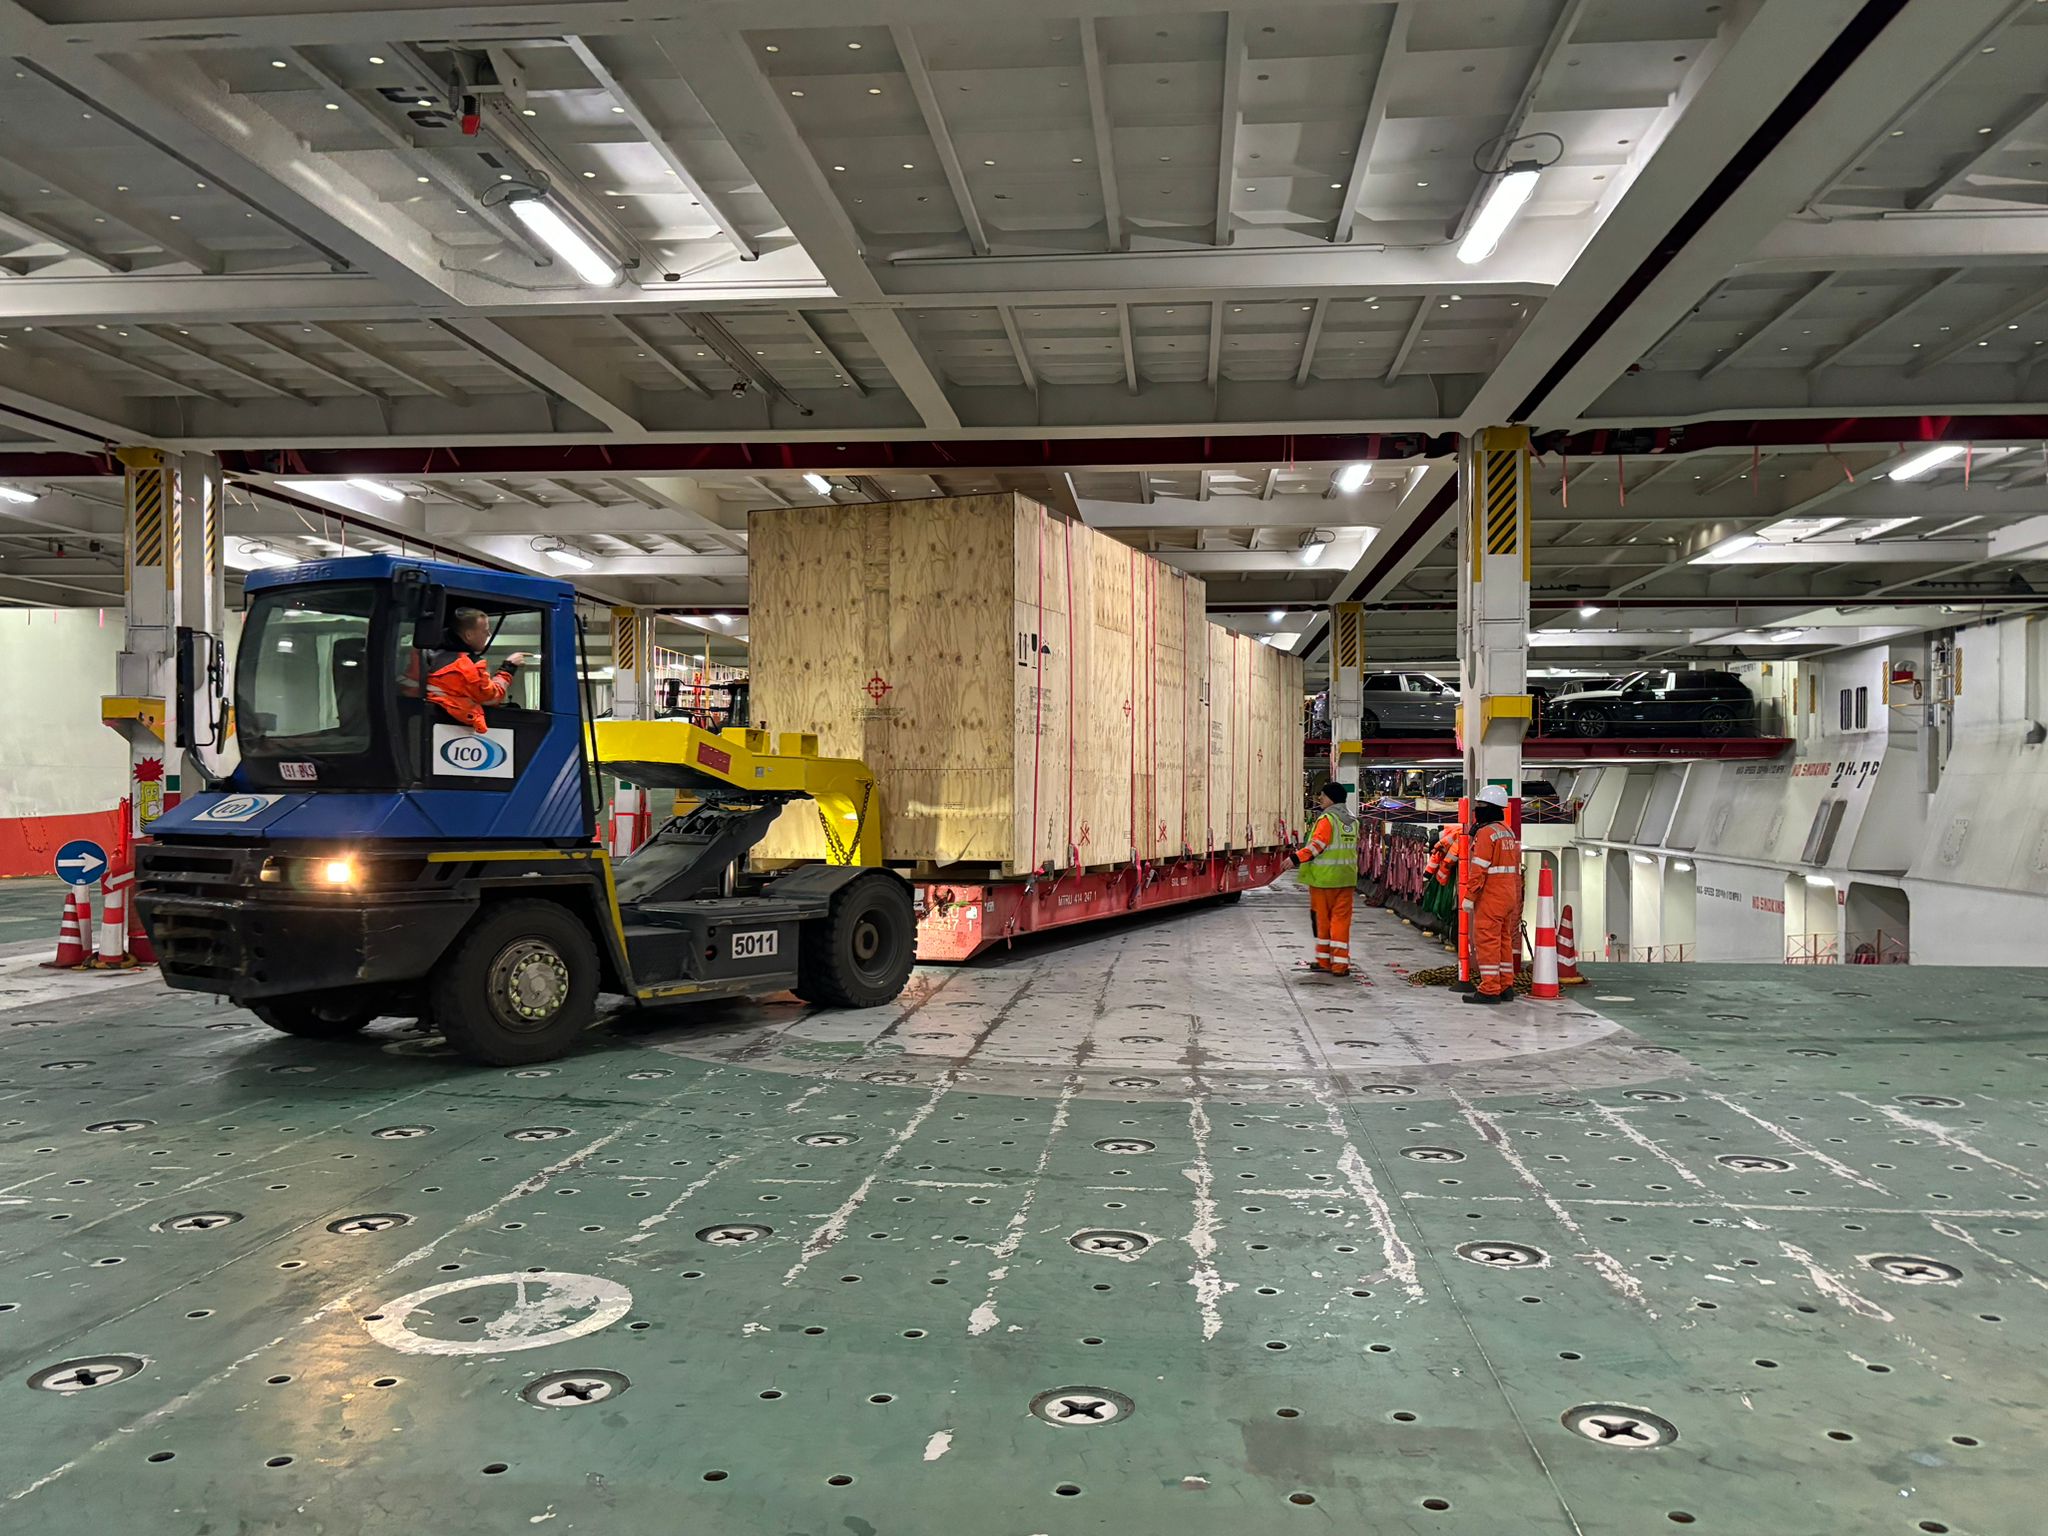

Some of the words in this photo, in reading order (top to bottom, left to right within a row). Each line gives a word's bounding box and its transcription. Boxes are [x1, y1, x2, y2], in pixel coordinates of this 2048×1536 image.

[453, 746, 482, 762] ICO
[1801, 763, 1831, 776] SMOKING
[215, 803, 247, 814] ICO
[967, 920, 974, 932] 1
[735, 933, 774, 956] 5011
